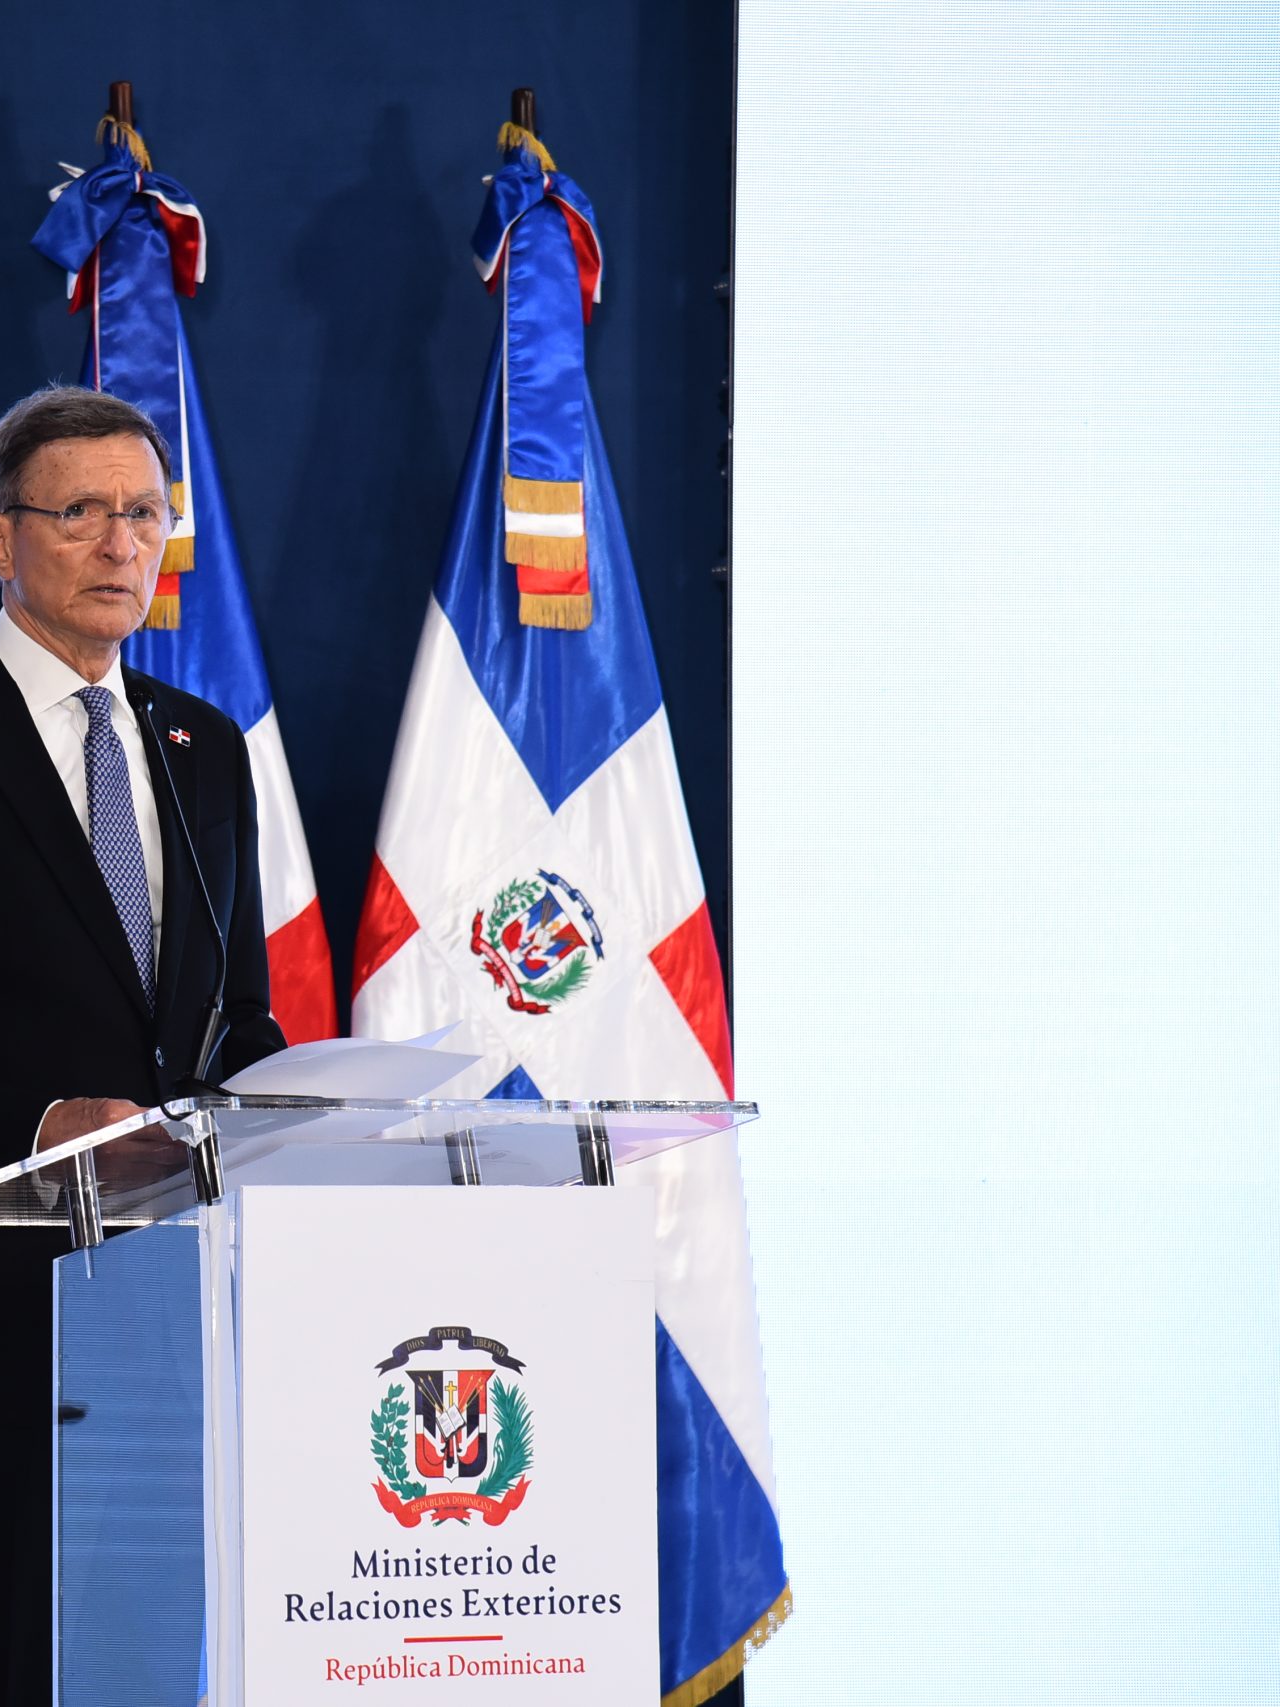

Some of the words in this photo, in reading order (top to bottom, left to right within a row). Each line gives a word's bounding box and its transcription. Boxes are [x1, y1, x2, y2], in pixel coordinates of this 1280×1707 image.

[406, 1338, 425, 1352] DIOS
[437, 1328, 465, 1339] PATRIA
[472, 1338, 505, 1357] LIBERTAD
[452, 1495, 492, 1512] DOMINICANA
[351, 1546, 513, 1578] Ministerio
[522, 1544, 557, 1574] de
[284, 1591, 453, 1622] Relaciones
[462, 1586, 622, 1617] Exteriores
[325, 1655, 442, 1686] República
[448, 1652, 586, 1677] Dominicana
